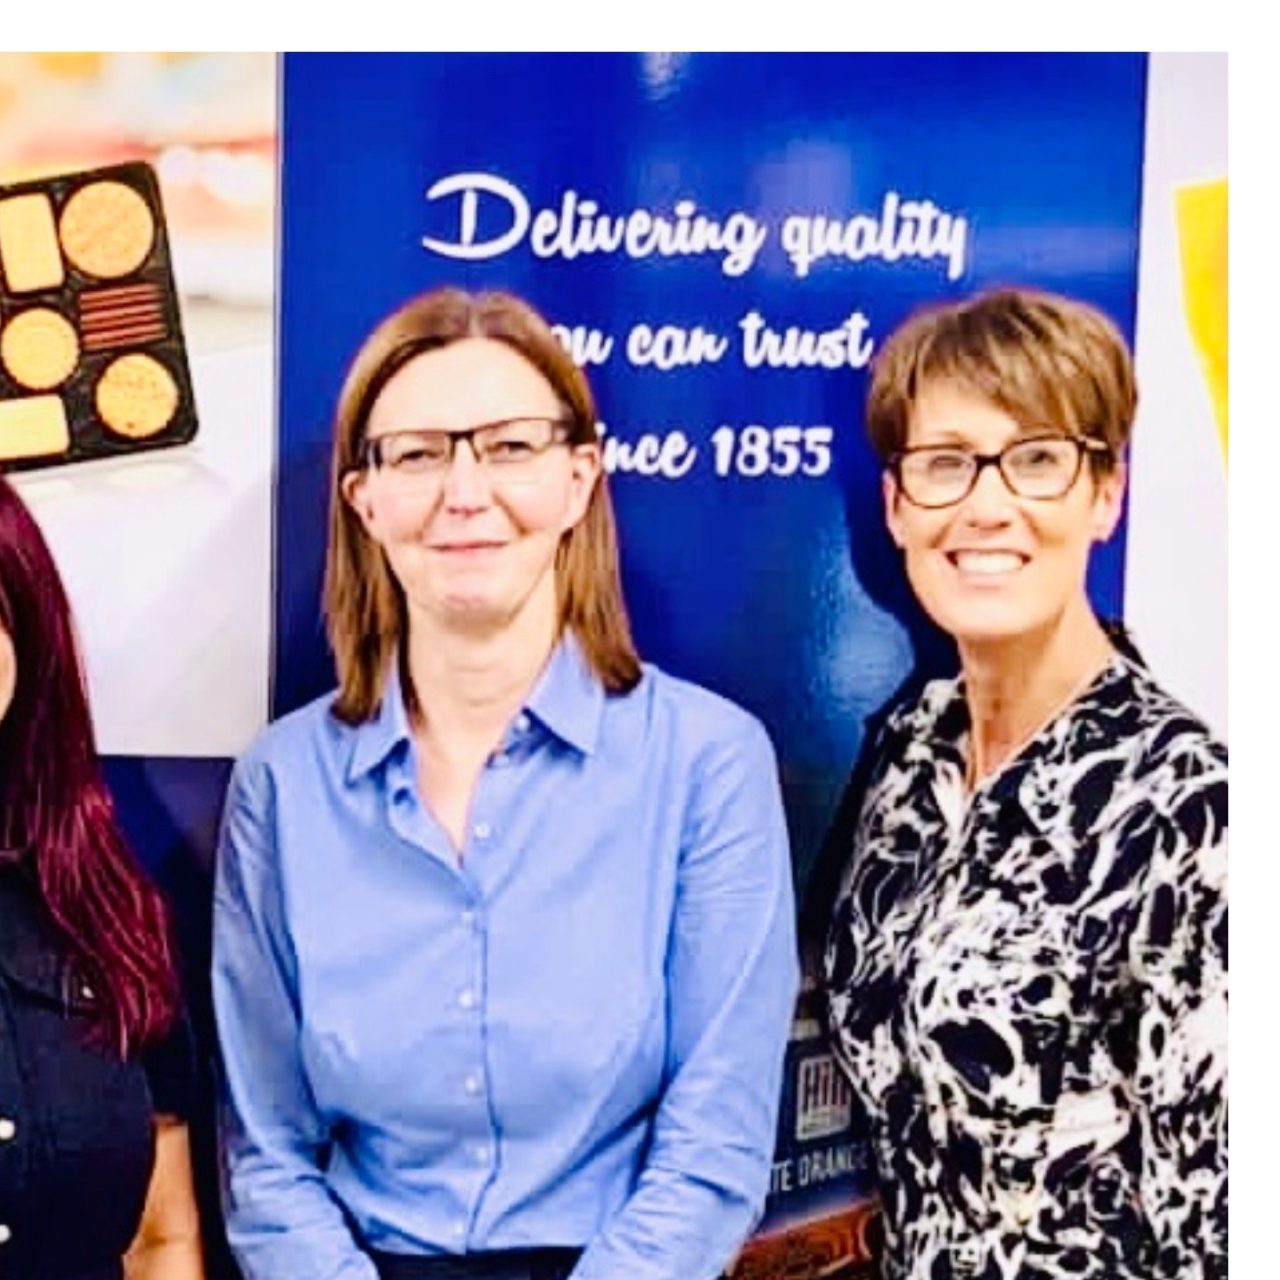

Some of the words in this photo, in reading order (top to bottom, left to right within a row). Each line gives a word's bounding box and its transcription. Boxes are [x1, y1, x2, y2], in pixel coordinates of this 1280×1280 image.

[422, 172, 766, 277] Delivering
[780, 191, 969, 281] quality
[551, 323, 614, 369] ou
[627, 322, 727, 370] can
[738, 311, 873, 369] trust
[711, 426, 833, 478] 1855
